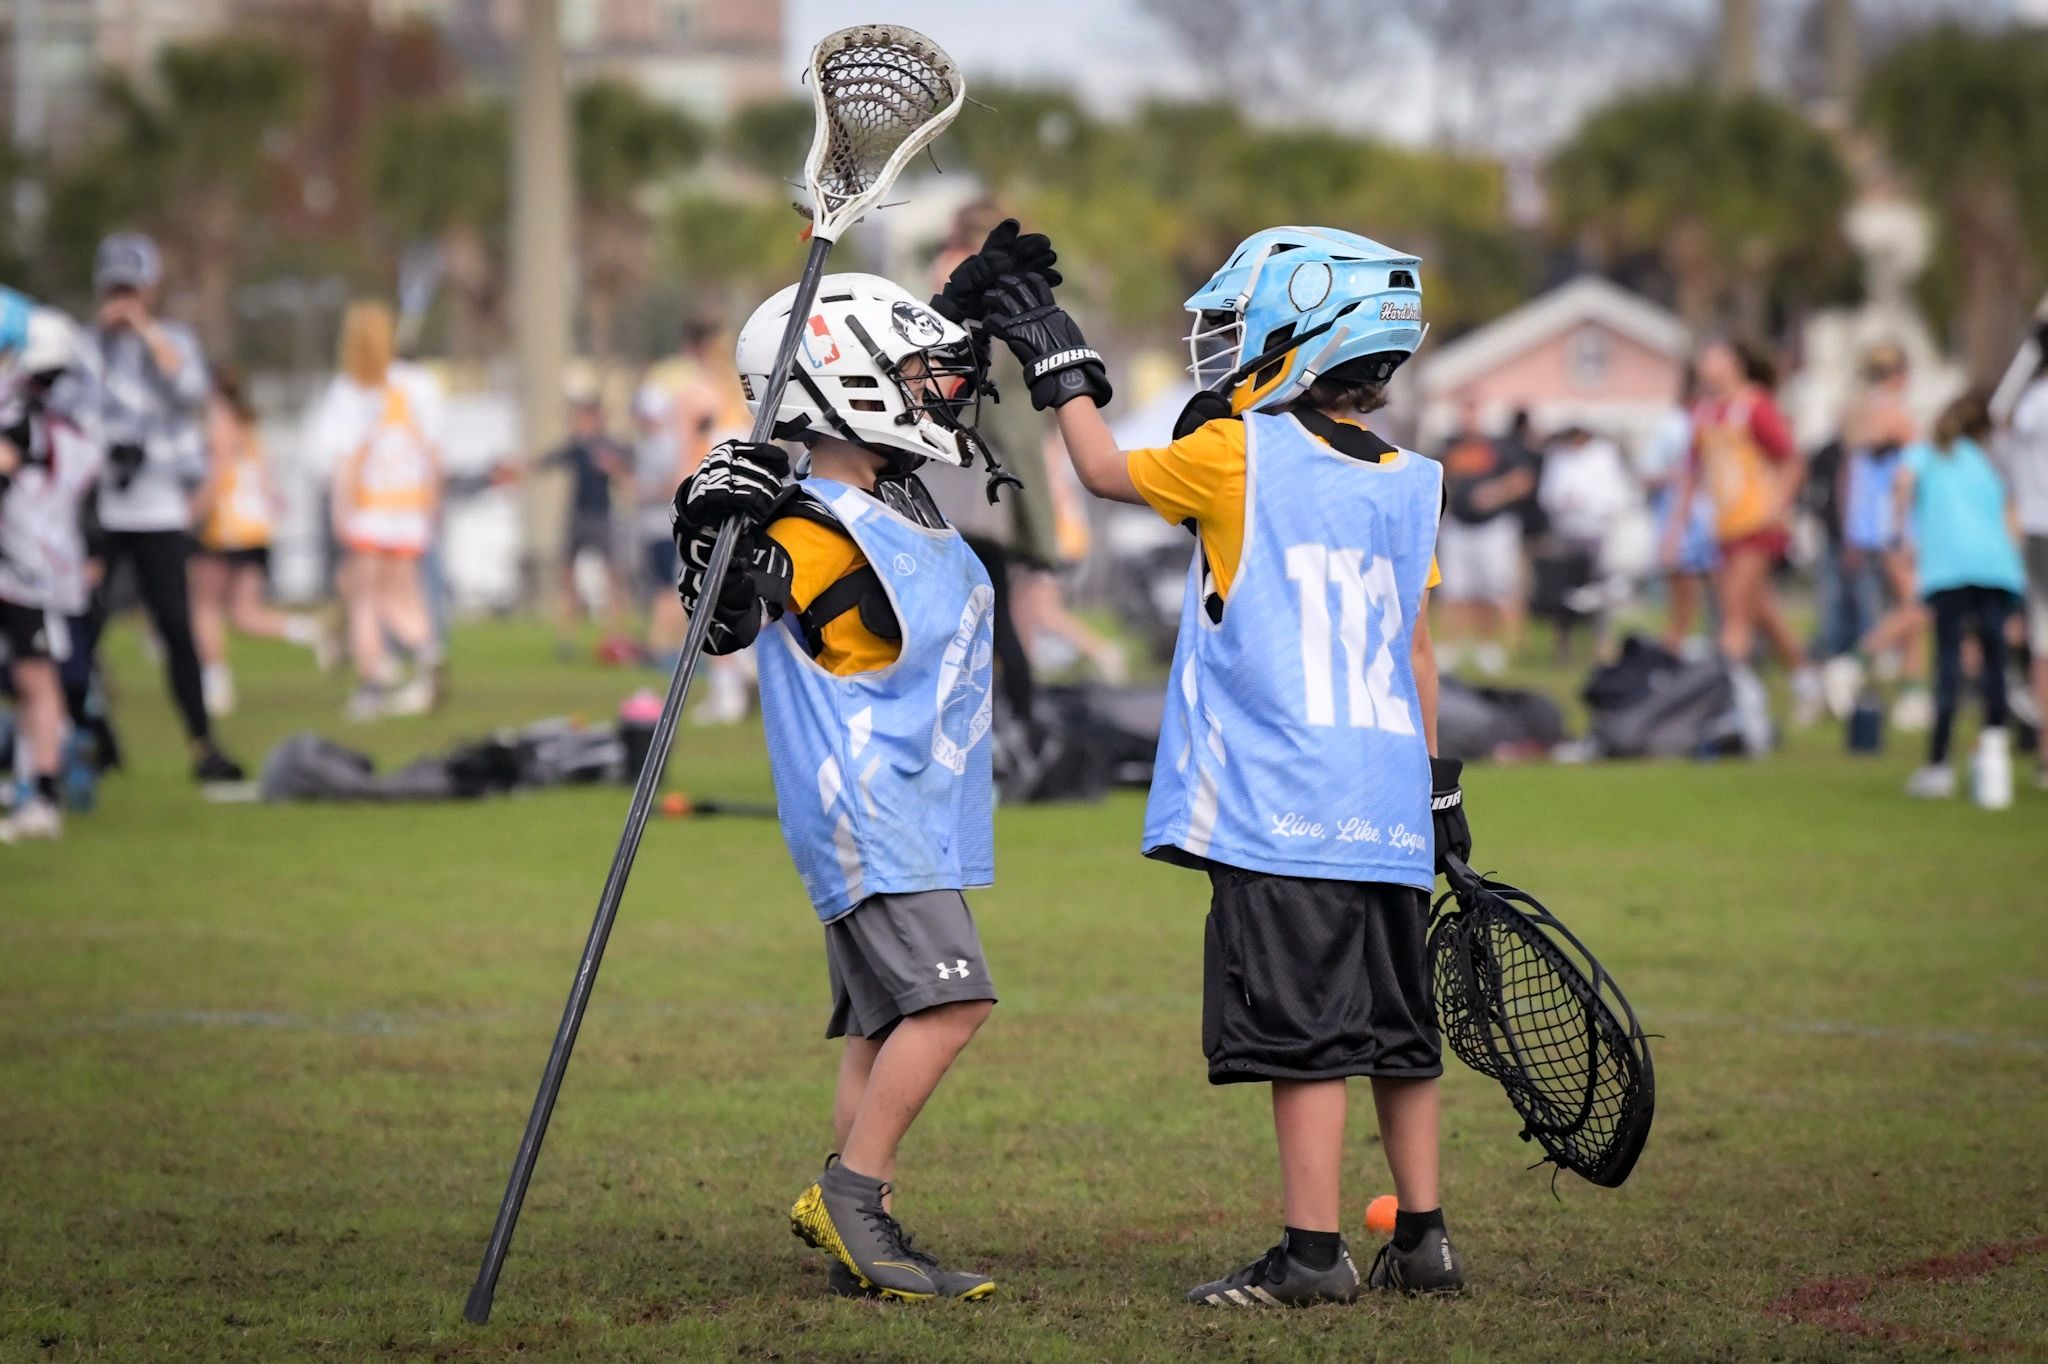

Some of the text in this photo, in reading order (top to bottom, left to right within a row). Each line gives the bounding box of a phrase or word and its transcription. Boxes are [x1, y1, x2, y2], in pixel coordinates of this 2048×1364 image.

[1284, 543, 1417, 736] 112
[1272, 812, 1326, 840] Live.
[1336, 817, 1382, 844] Like.
